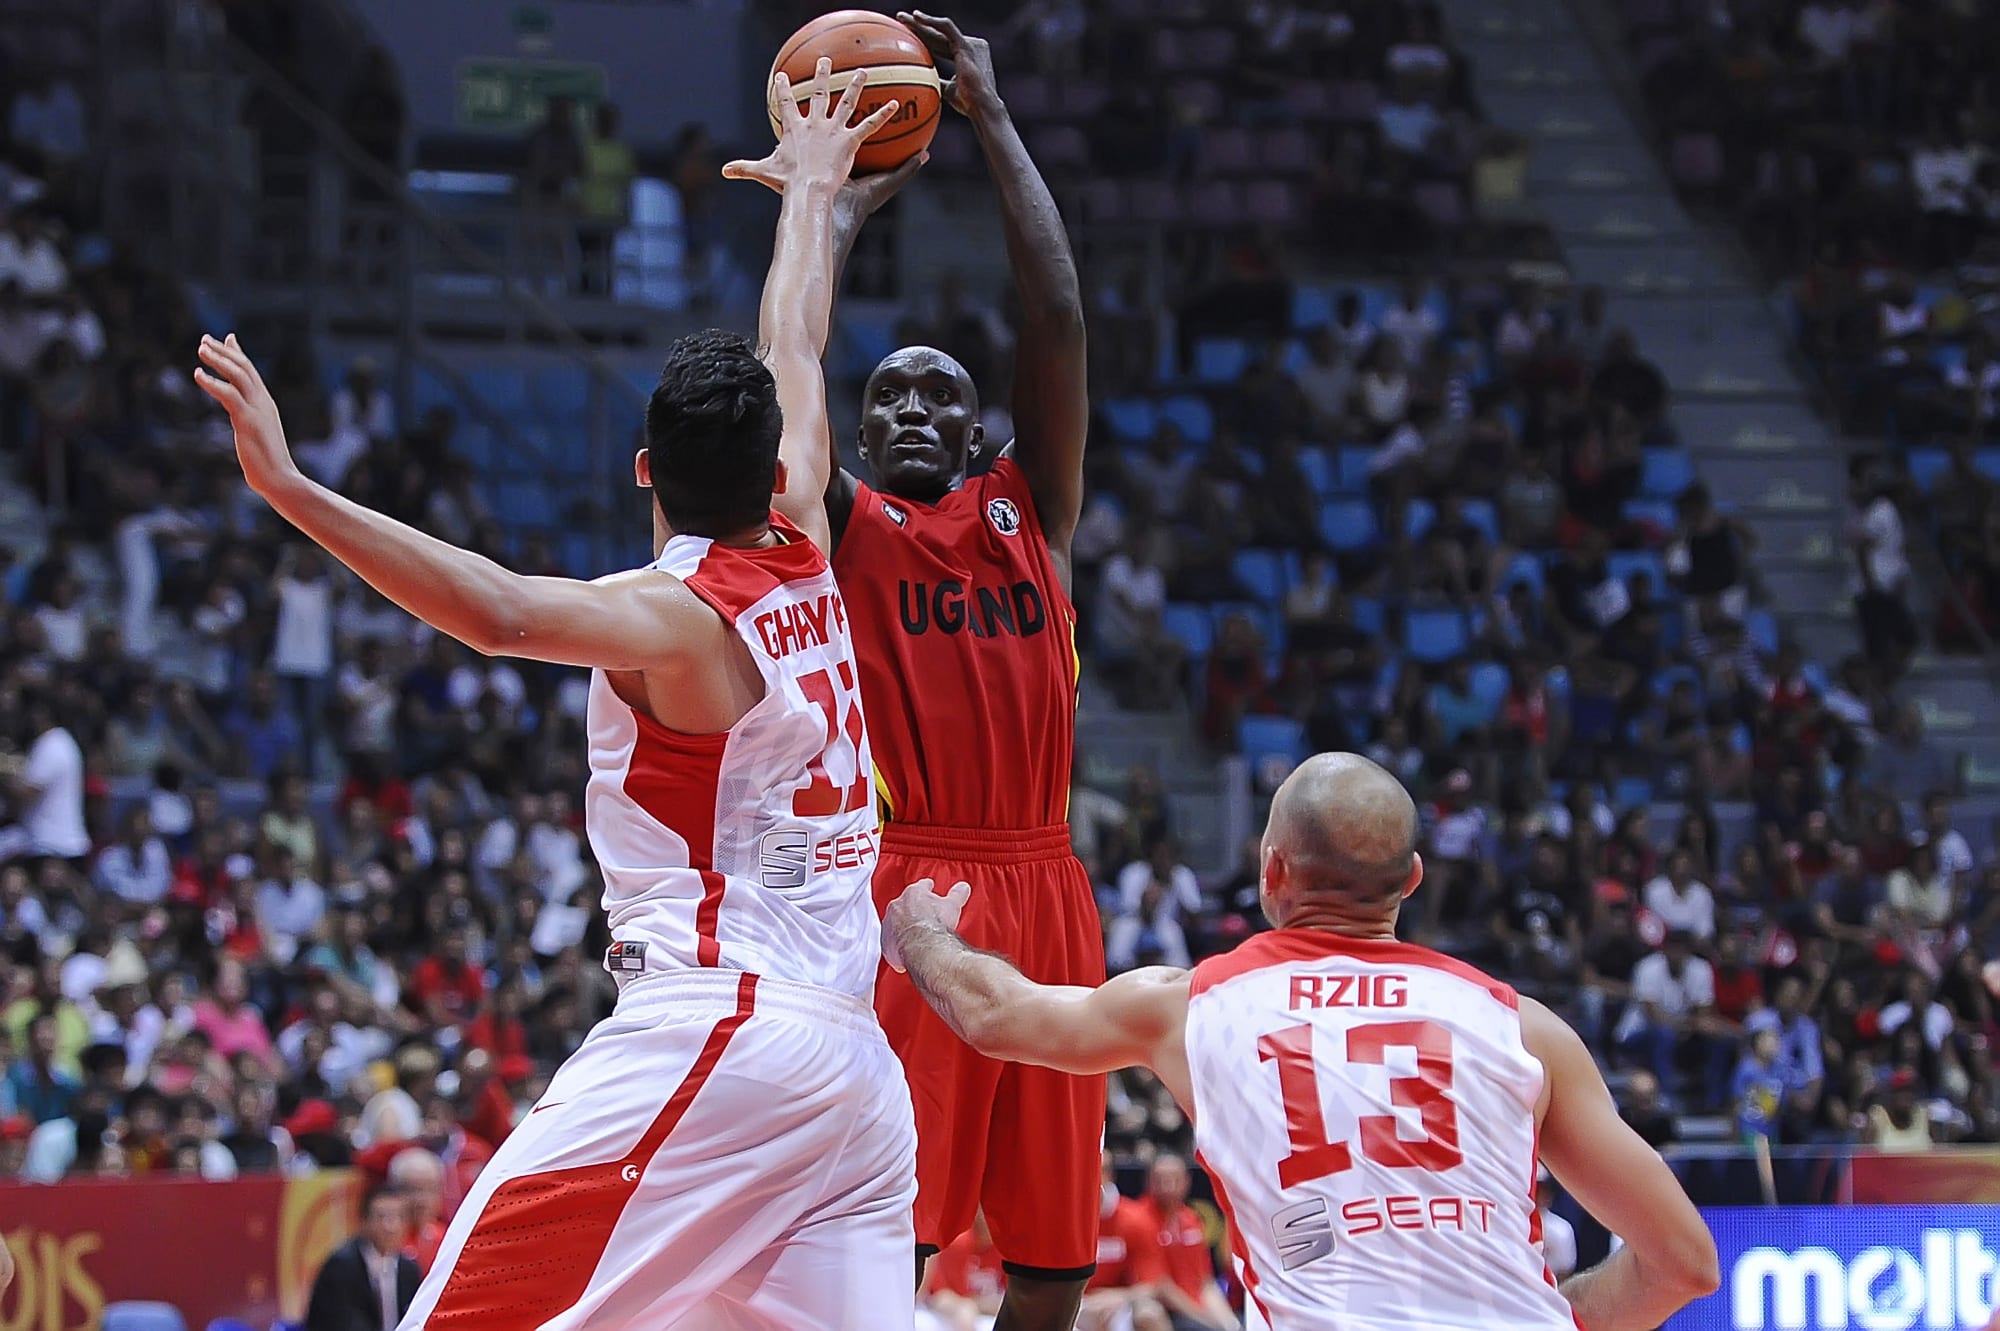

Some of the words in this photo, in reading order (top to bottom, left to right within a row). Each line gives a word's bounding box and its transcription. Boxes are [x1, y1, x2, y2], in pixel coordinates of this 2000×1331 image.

[625, 945, 636, 956] 54
[1289, 974, 1408, 1011] RZIG
[1257, 1020, 1464, 1190] 13
[1341, 1196, 1497, 1236] SEAT
[1732, 1227, 2000, 1331] molt
